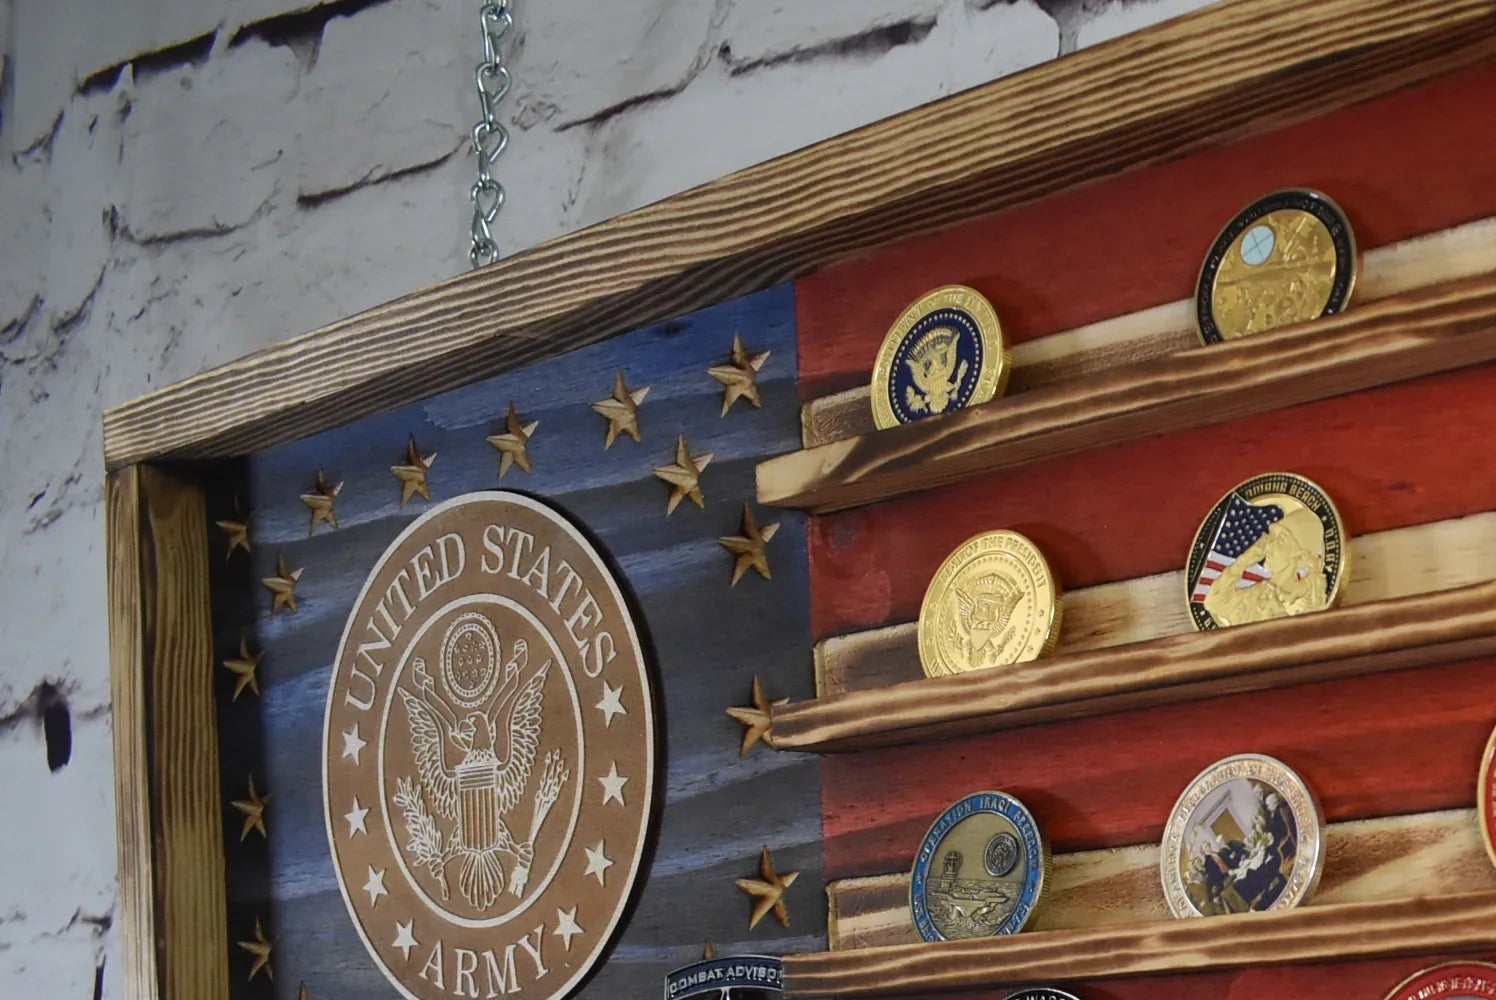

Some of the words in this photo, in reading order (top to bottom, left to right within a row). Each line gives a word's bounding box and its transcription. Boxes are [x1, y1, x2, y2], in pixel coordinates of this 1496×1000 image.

[1243, 481, 1288, 499] OMAHA
[1289, 482, 1321, 511] BEACH
[980, 536, 1003, 550] THE
[344, 534, 468, 711] UNITED
[480, 524, 617, 679] STATES
[920, 801, 973, 863] OPERATION
[979, 796, 1010, 813] IRAQI
[419, 923, 549, 998] ARMY
[669, 967, 723, 994] COMBAT
